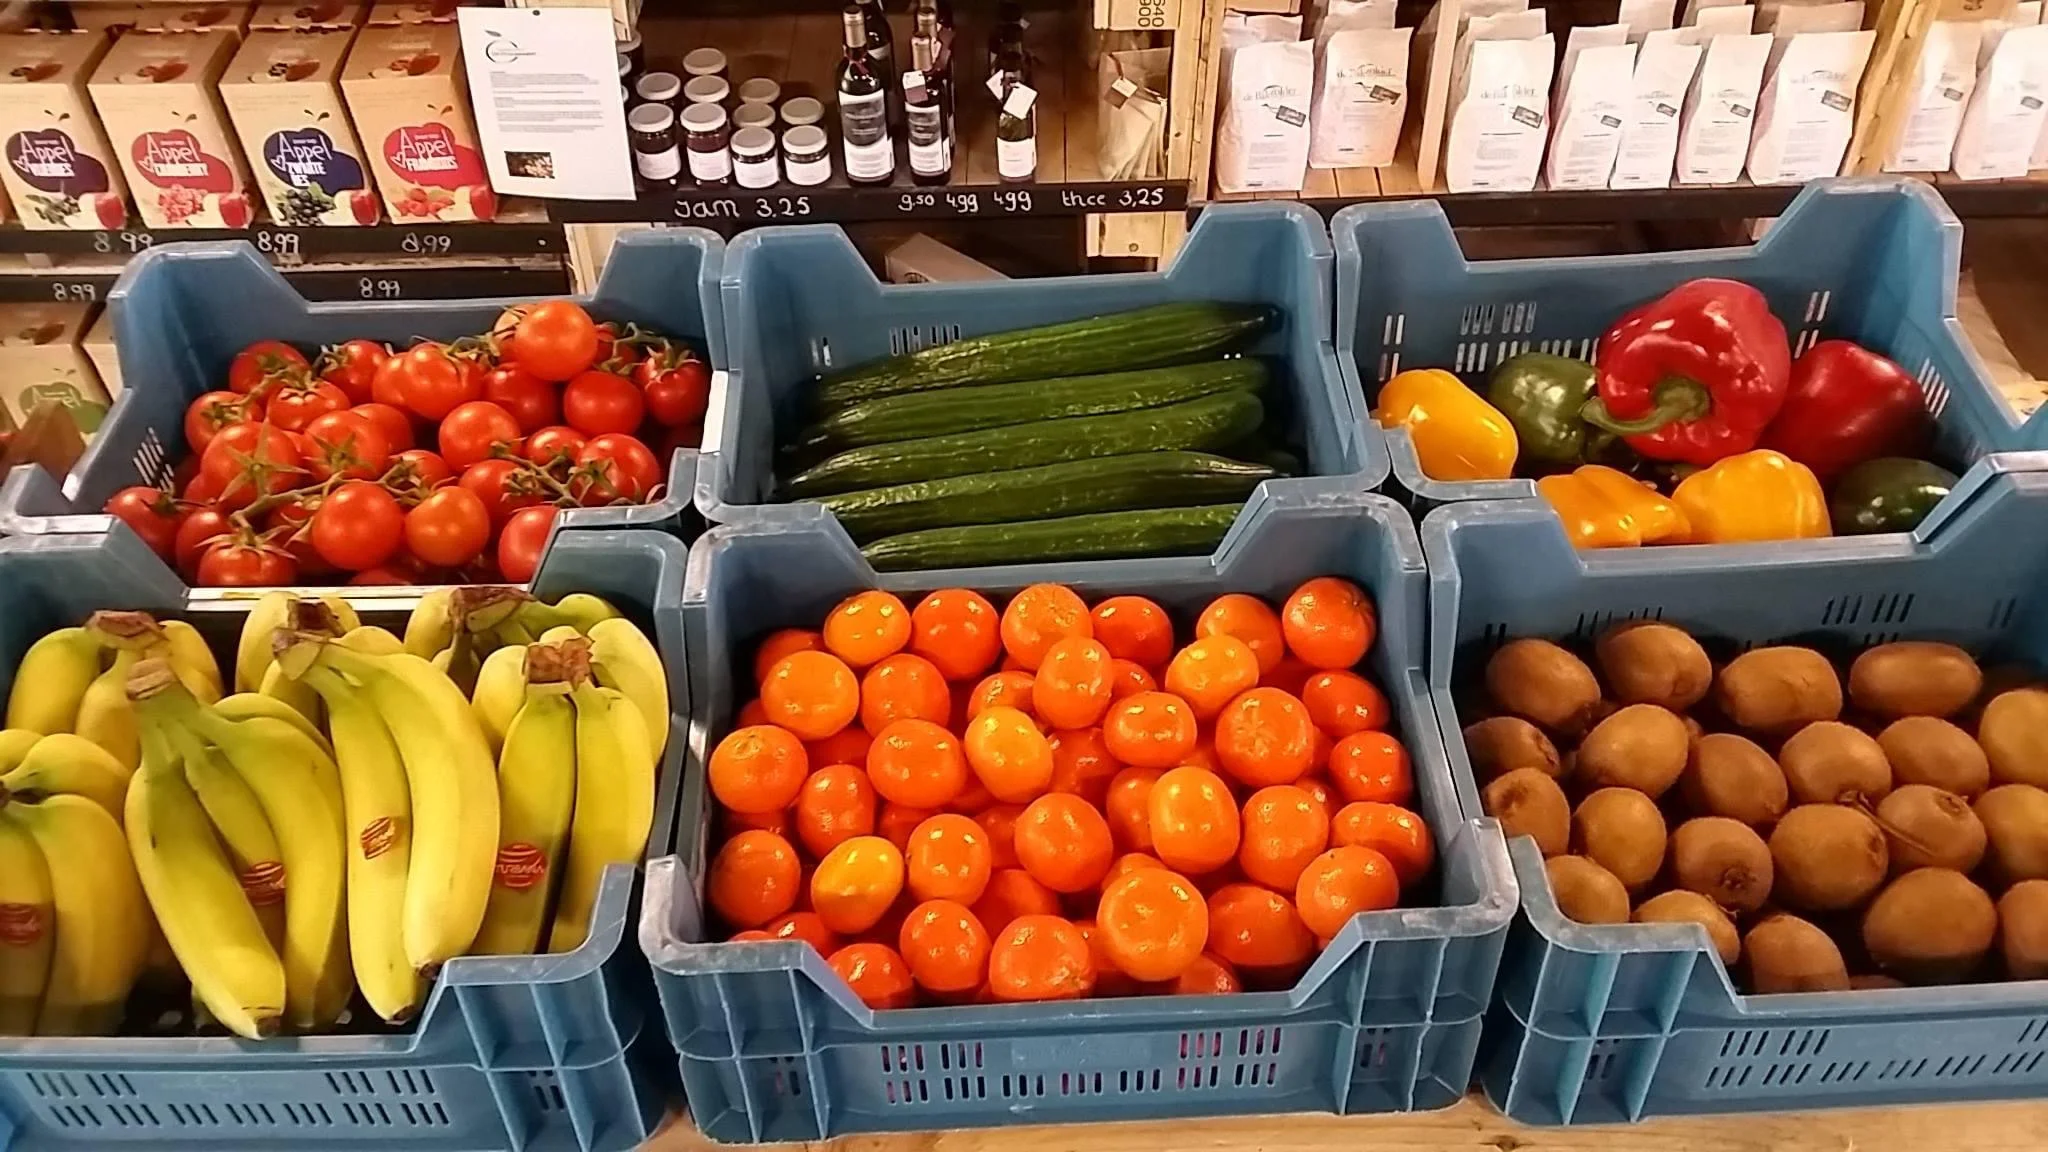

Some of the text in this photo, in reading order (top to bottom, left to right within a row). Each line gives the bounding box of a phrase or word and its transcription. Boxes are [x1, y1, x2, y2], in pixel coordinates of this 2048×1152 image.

[20, 133, 76, 164] Appel
[146, 134, 201, 164] Appel
[279, 132, 333, 163] Appel
[400, 127, 454, 160] Appel
[756, 197, 811, 218] 3.25
